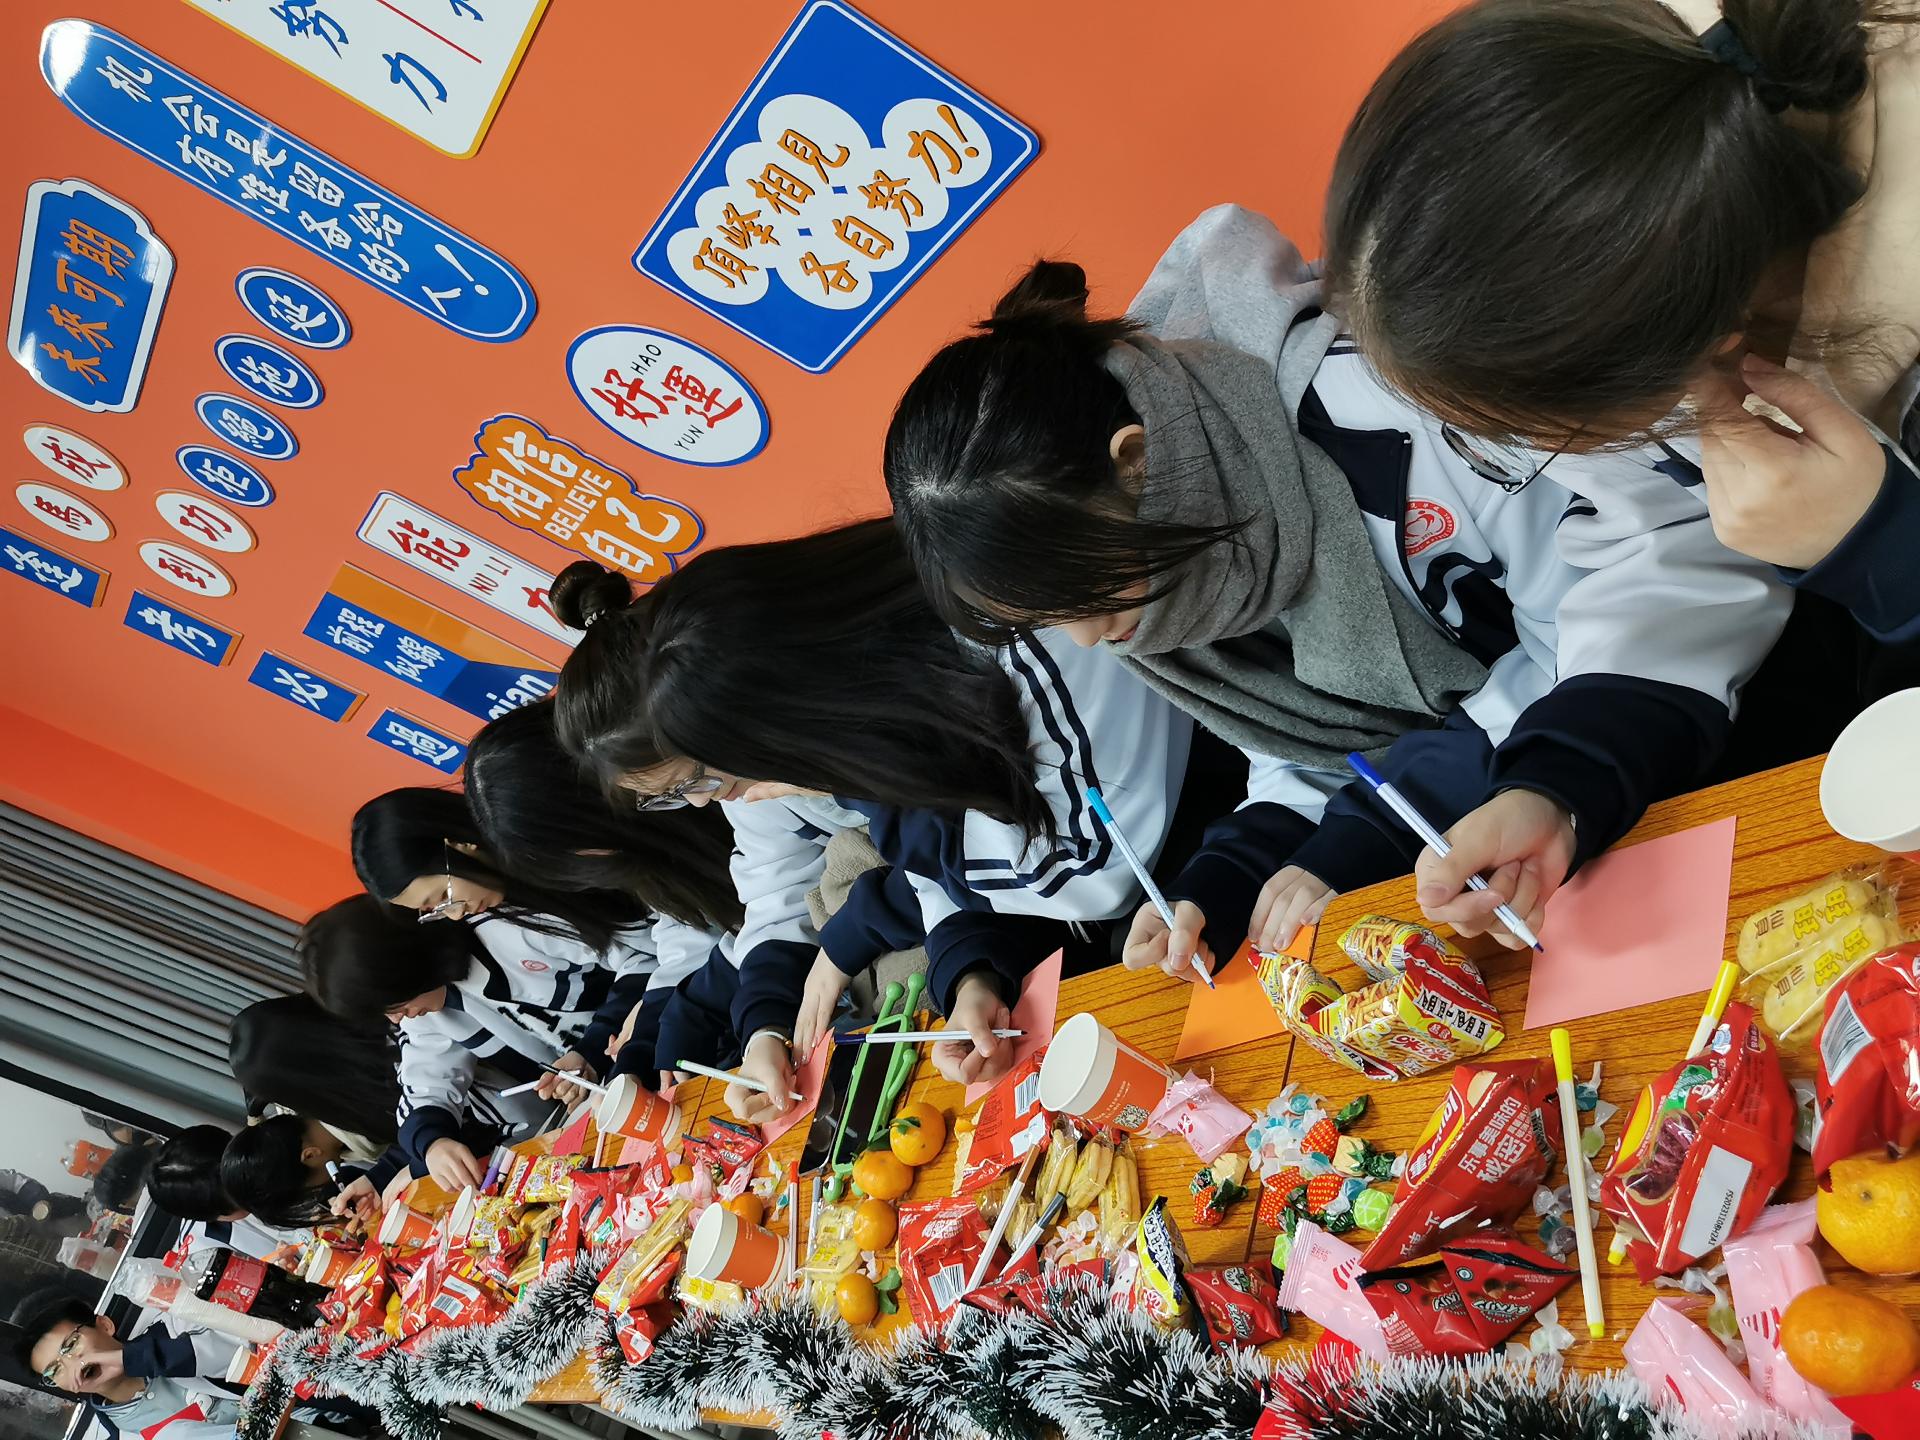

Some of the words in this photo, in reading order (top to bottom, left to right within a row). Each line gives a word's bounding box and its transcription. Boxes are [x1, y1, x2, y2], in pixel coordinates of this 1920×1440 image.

[693, 129, 851, 289] 頂峰相見
[630, 344, 661, 375] HAO
[474, 431, 578, 520] 相信
[673, 425, 704, 451] YUN
[544, 469, 612, 540] BELIEVE
[579, 496, 681, 575] 自己
[1457, 1096, 1522, 1174] 乐事美味的
